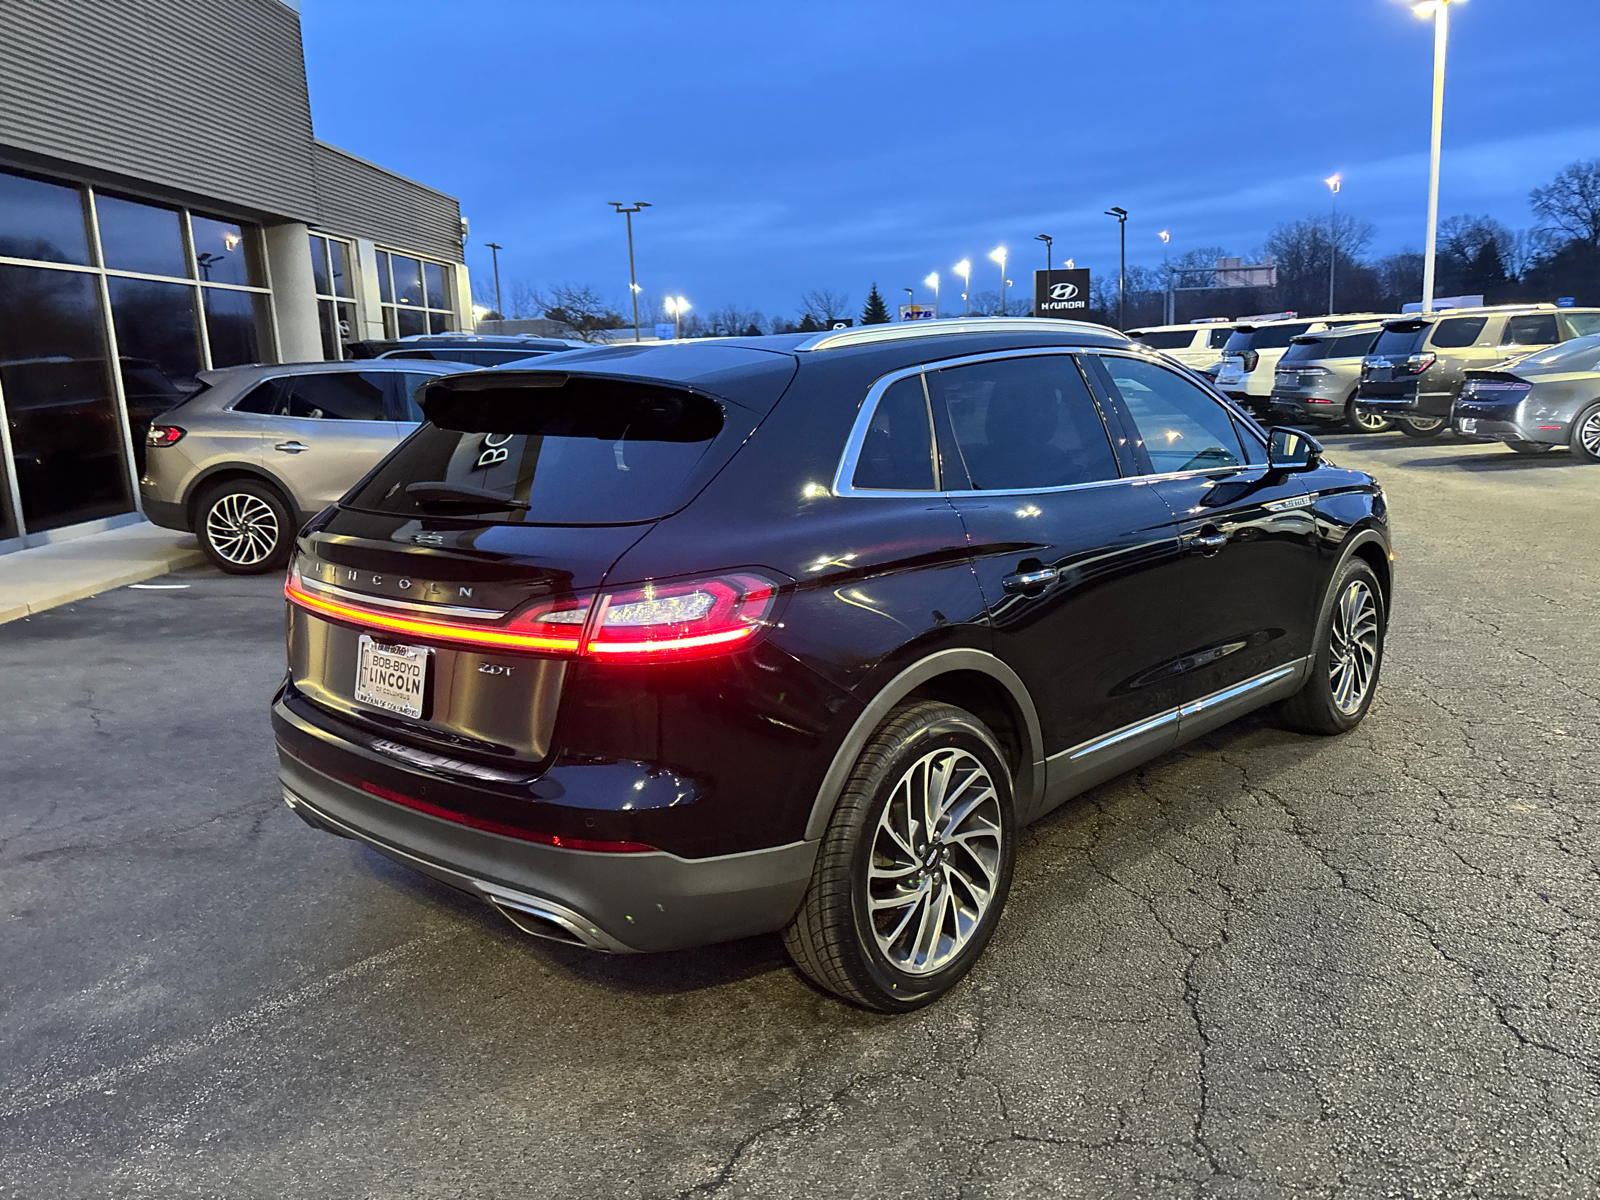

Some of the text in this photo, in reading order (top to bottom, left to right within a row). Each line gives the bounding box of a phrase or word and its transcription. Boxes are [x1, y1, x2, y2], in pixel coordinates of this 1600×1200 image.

[904, 310, 932, 319] NTB
[1041, 300, 1085, 311] HYUNDAI
[315, 562, 473, 598] LINCOLN
[369, 667, 421, 695] LINCOLN
